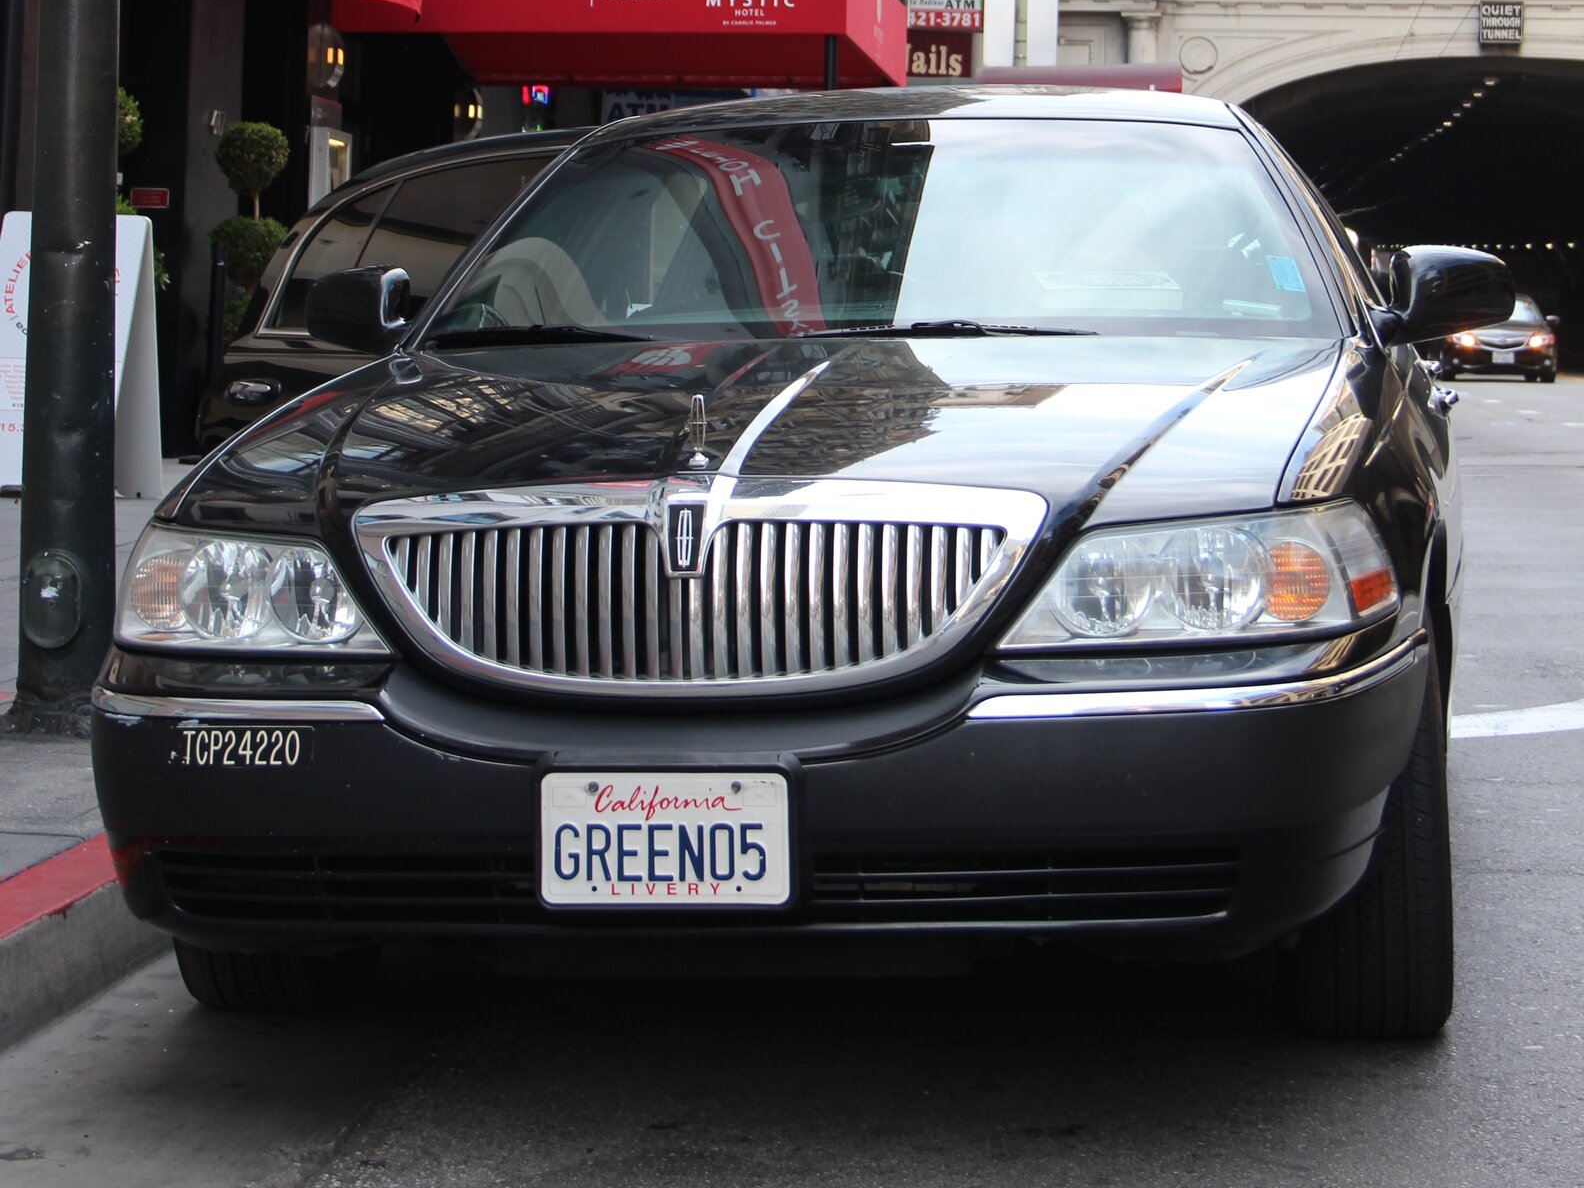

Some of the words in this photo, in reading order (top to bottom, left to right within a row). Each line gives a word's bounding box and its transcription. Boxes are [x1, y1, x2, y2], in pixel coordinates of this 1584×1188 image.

[944, 0, 975, 10] ATM
[1481, 4, 1521, 17] QUIET
[734, 8, 765, 17] HOTEL
[1481, 16, 1521, 28] THROUGH
[1482, 28, 1522, 40] TUNNEL
[183, 729, 301, 766] TCP24220
[594, 784, 742, 821] California
[611, 882, 722, 896] LIVERY
